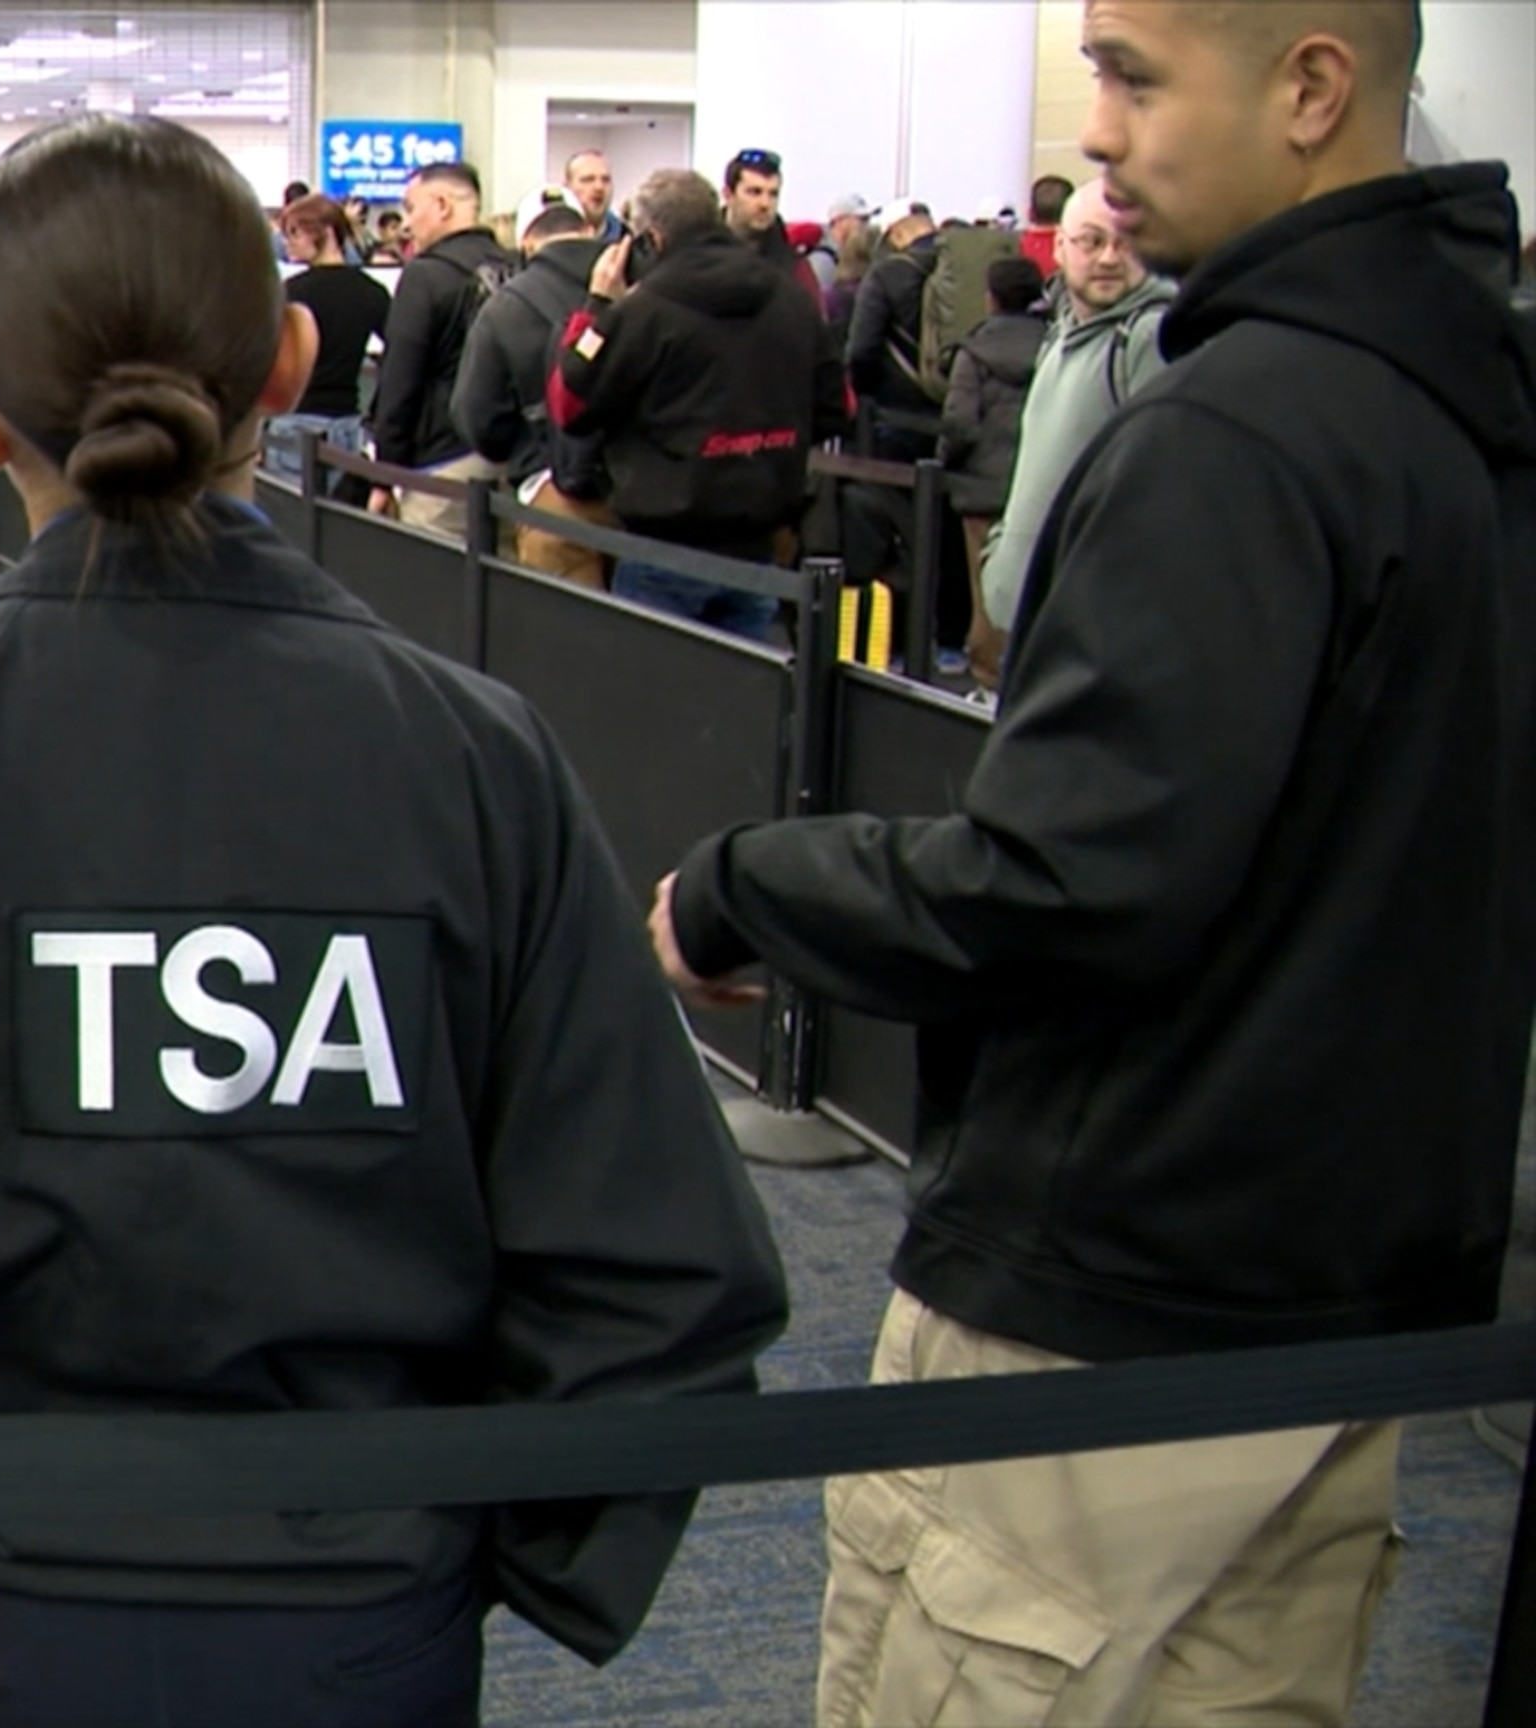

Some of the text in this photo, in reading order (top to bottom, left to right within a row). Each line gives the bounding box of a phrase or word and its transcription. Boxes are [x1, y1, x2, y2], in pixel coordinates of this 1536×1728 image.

[329, 132, 457, 167] $45 fee
[31, 924, 405, 1113] TSA
